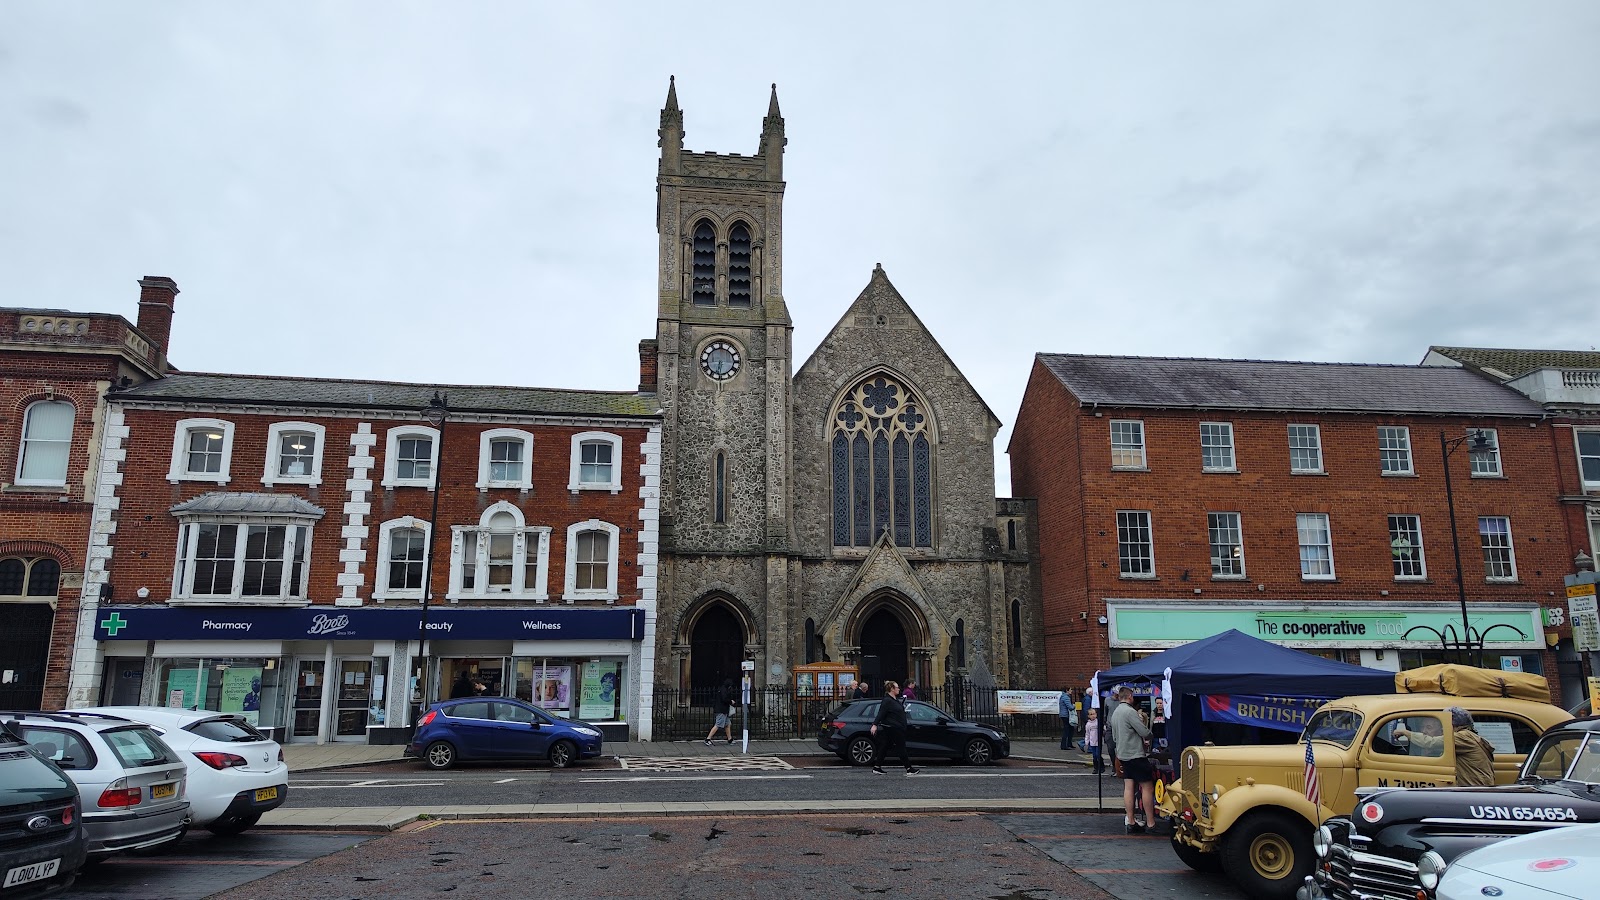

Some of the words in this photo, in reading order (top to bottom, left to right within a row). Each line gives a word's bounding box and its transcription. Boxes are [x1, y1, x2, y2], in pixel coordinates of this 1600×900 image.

[202, 620, 252, 632] Pharmacy
[306, 614, 349, 635] Boots
[522, 620, 562, 631] Wellness
[1255, 619, 1278, 634] The
[1282, 620, 1366, 638] co-operative
[1374, 620, 1404, 636] food
[1237, 702, 1307, 726] BRITISH
[1470, 805, 1511, 820] USN
[1512, 807, 1578, 821] 654654
[35, 862, 55, 878] LYP
